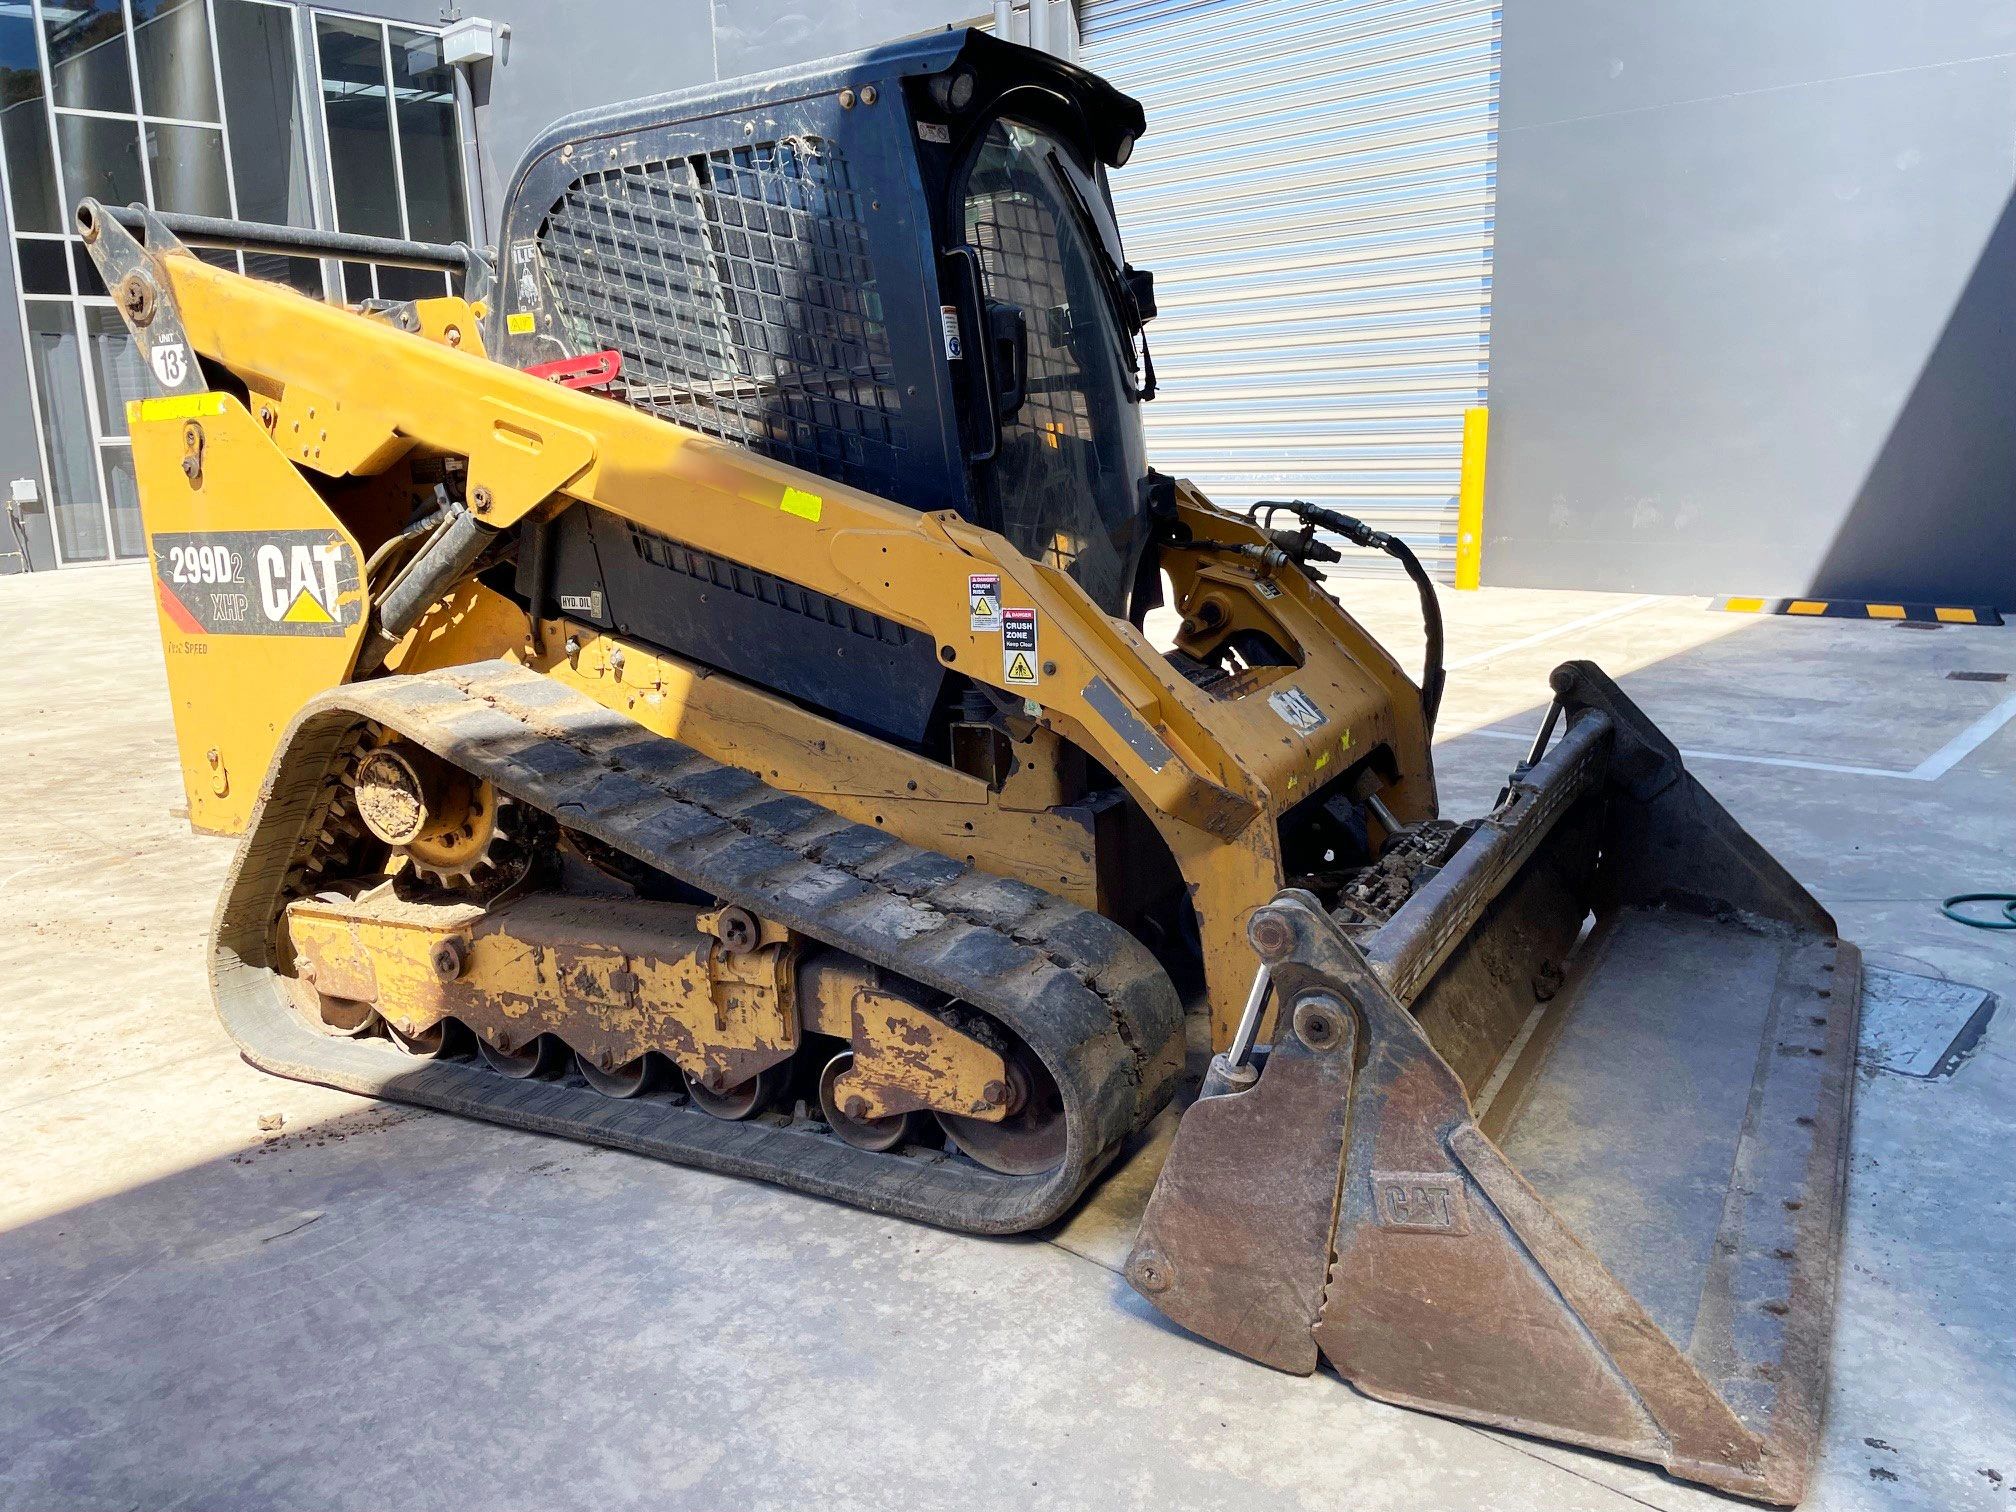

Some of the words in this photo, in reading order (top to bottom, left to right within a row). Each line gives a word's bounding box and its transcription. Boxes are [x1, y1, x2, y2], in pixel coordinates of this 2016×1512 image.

[159, 333, 174, 343] UNIT
[160, 350, 180, 380] 13
[257, 544, 342, 622] CAT
[211, 594, 249, 621] XHP
[1006, 622, 1033, 630] CRUSH
[1385, 1186, 1450, 1226] CAT
